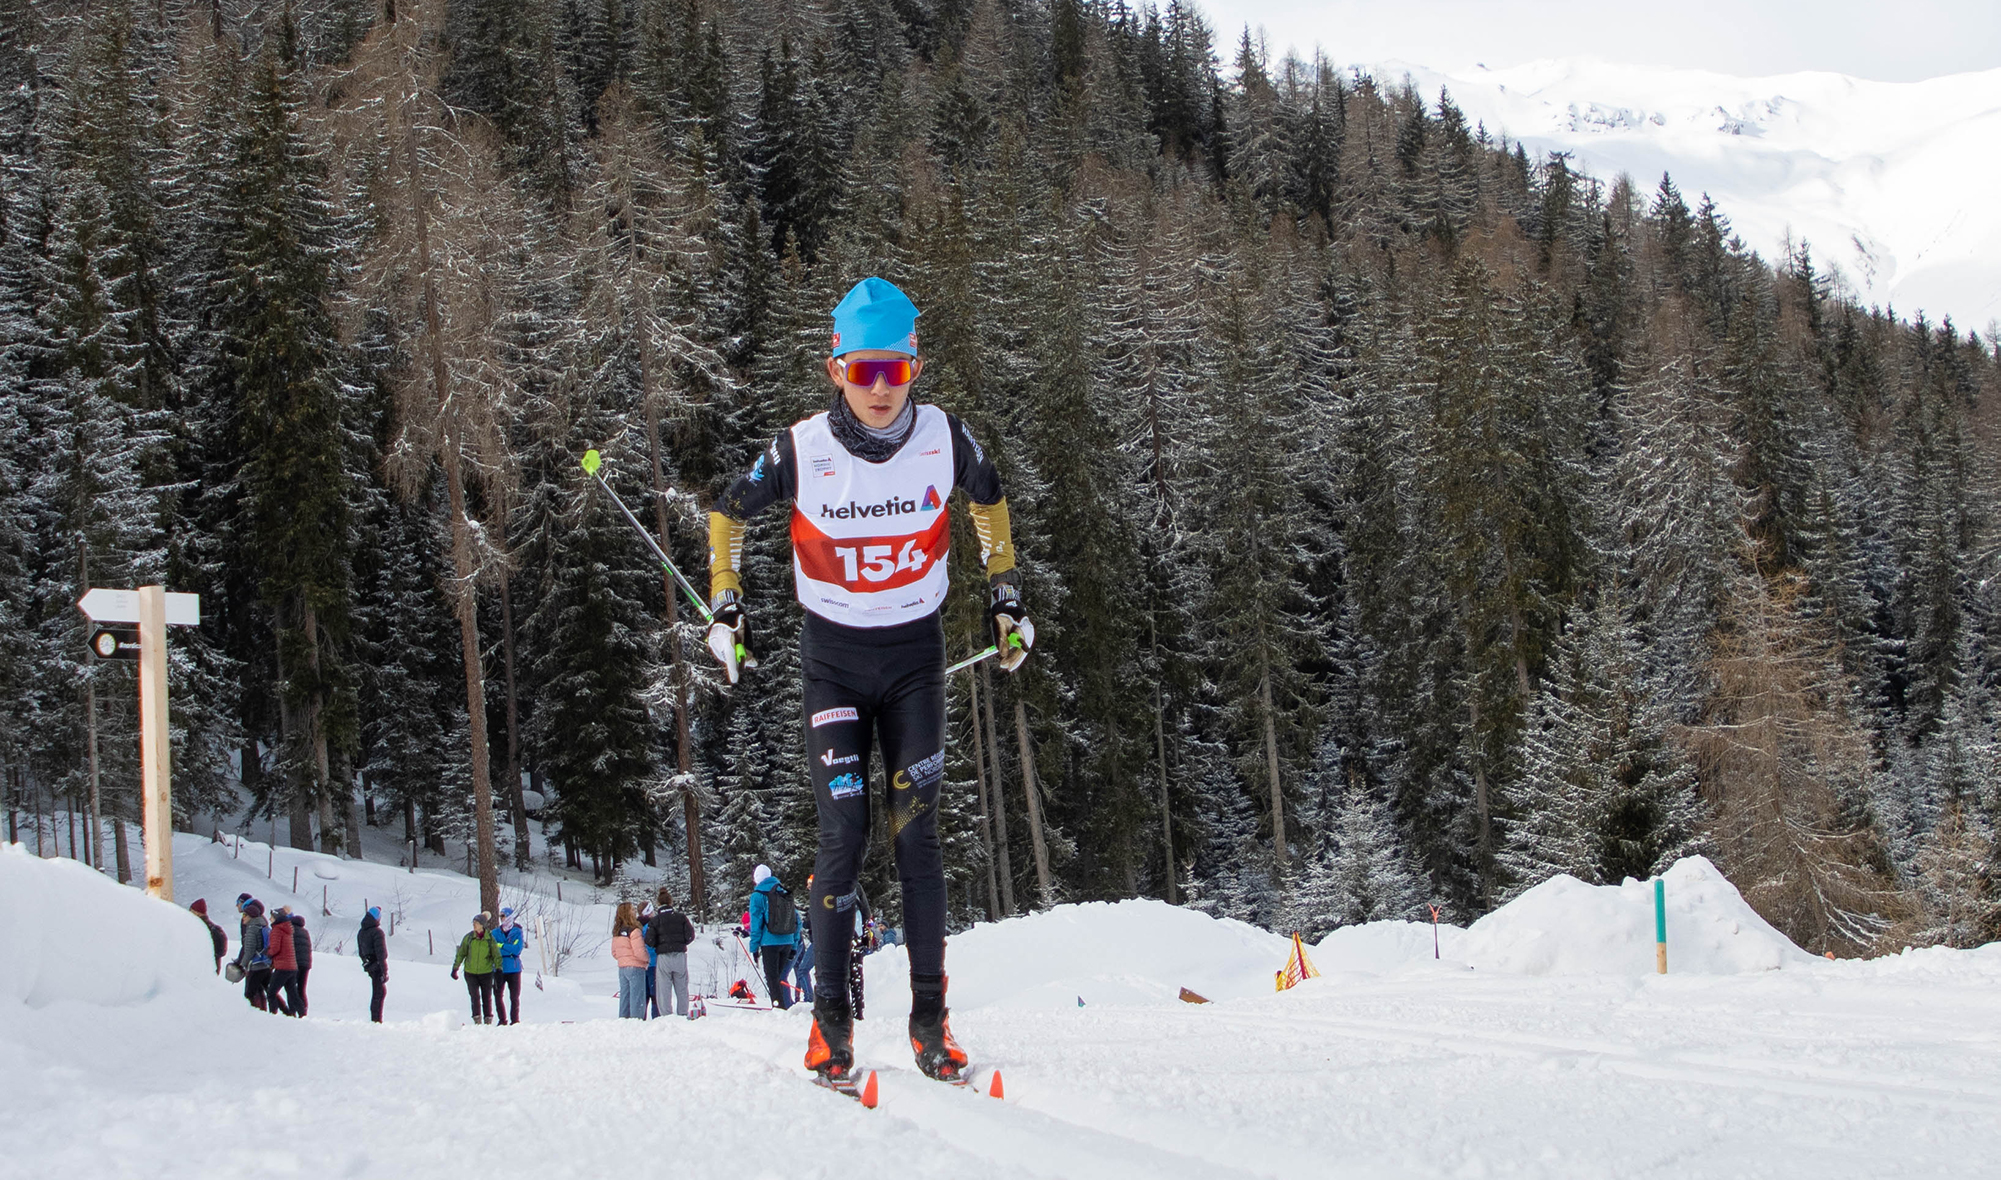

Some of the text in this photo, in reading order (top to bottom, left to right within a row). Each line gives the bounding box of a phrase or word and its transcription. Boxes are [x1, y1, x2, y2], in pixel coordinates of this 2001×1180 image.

[821, 496, 916, 519] helvetia
[835, 539, 928, 581] 154
[821, 598, 849, 609] swisscom
[814, 709, 856, 724] RAIFFEISEN
[821, 748, 859, 766] Voegtli
[907, 757, 930, 772] CENTRE
